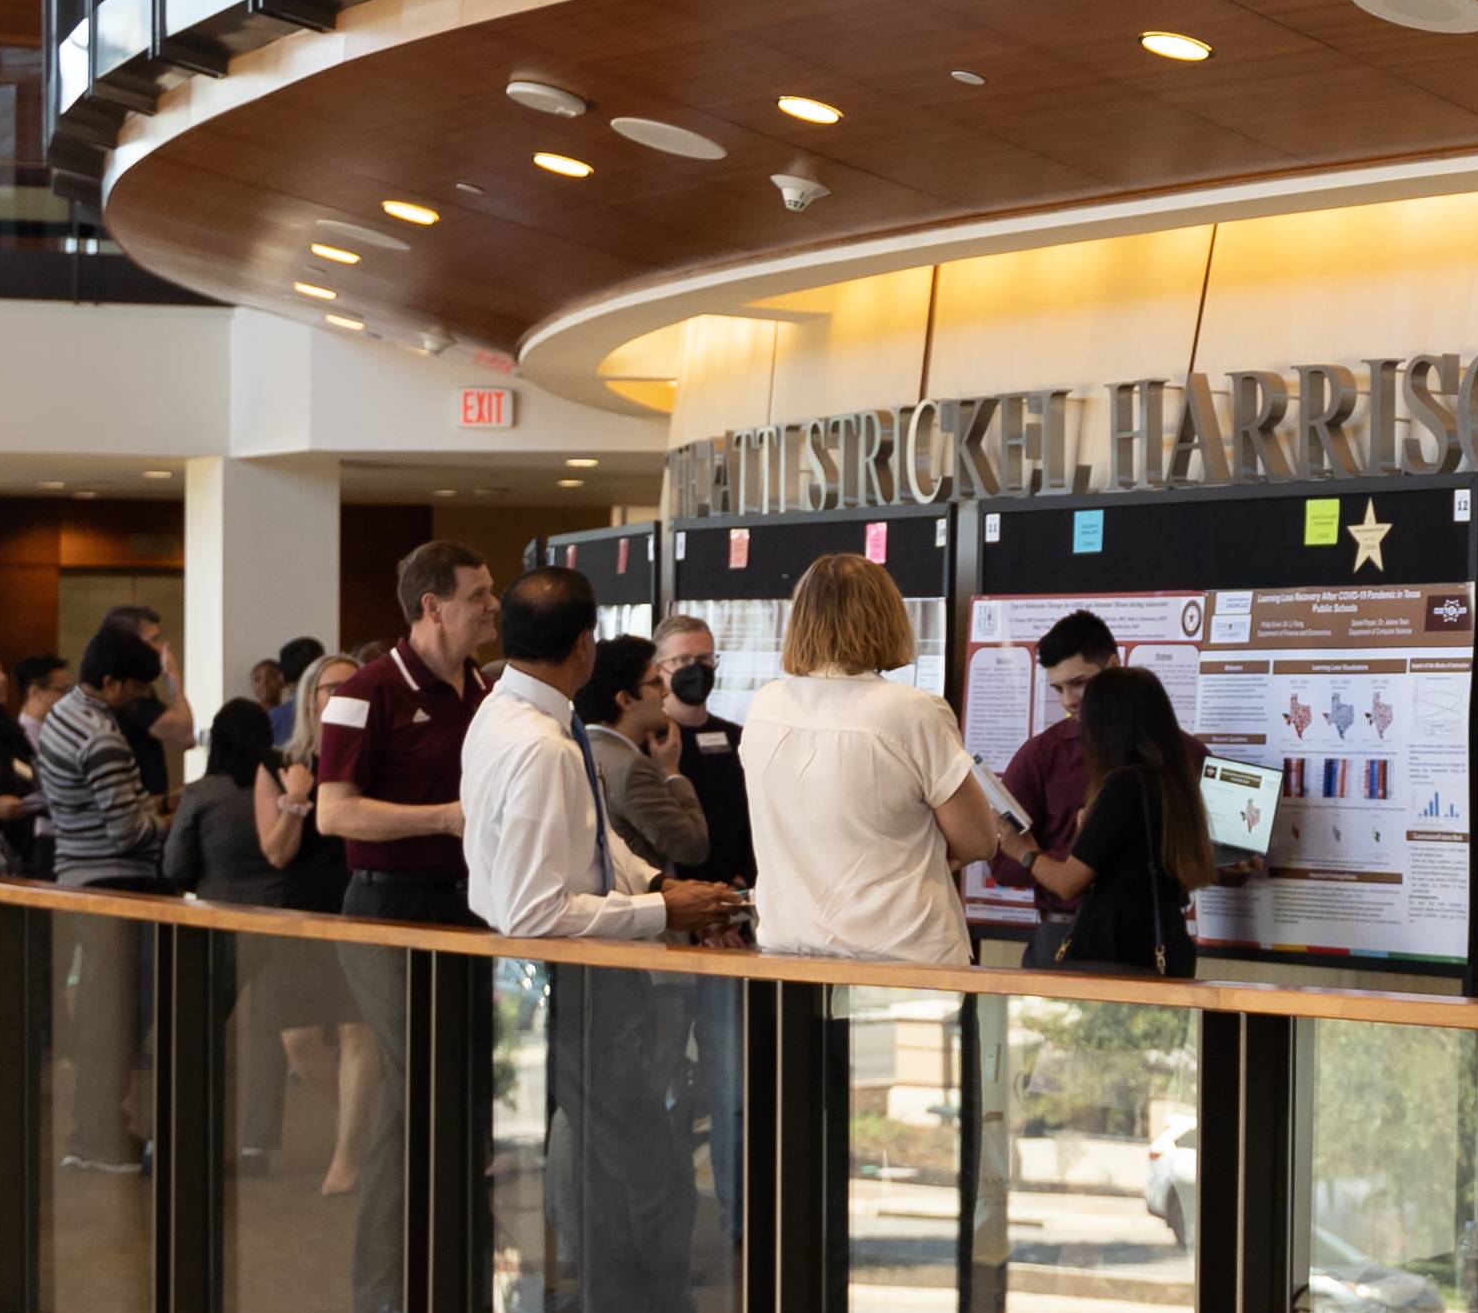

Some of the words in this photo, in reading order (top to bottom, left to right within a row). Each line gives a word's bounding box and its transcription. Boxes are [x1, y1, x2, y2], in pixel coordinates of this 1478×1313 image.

[461, 389, 505, 424] EXIT
[805, 389, 1093, 512] STRICKEL
[1457, 498, 1469, 511] 12
